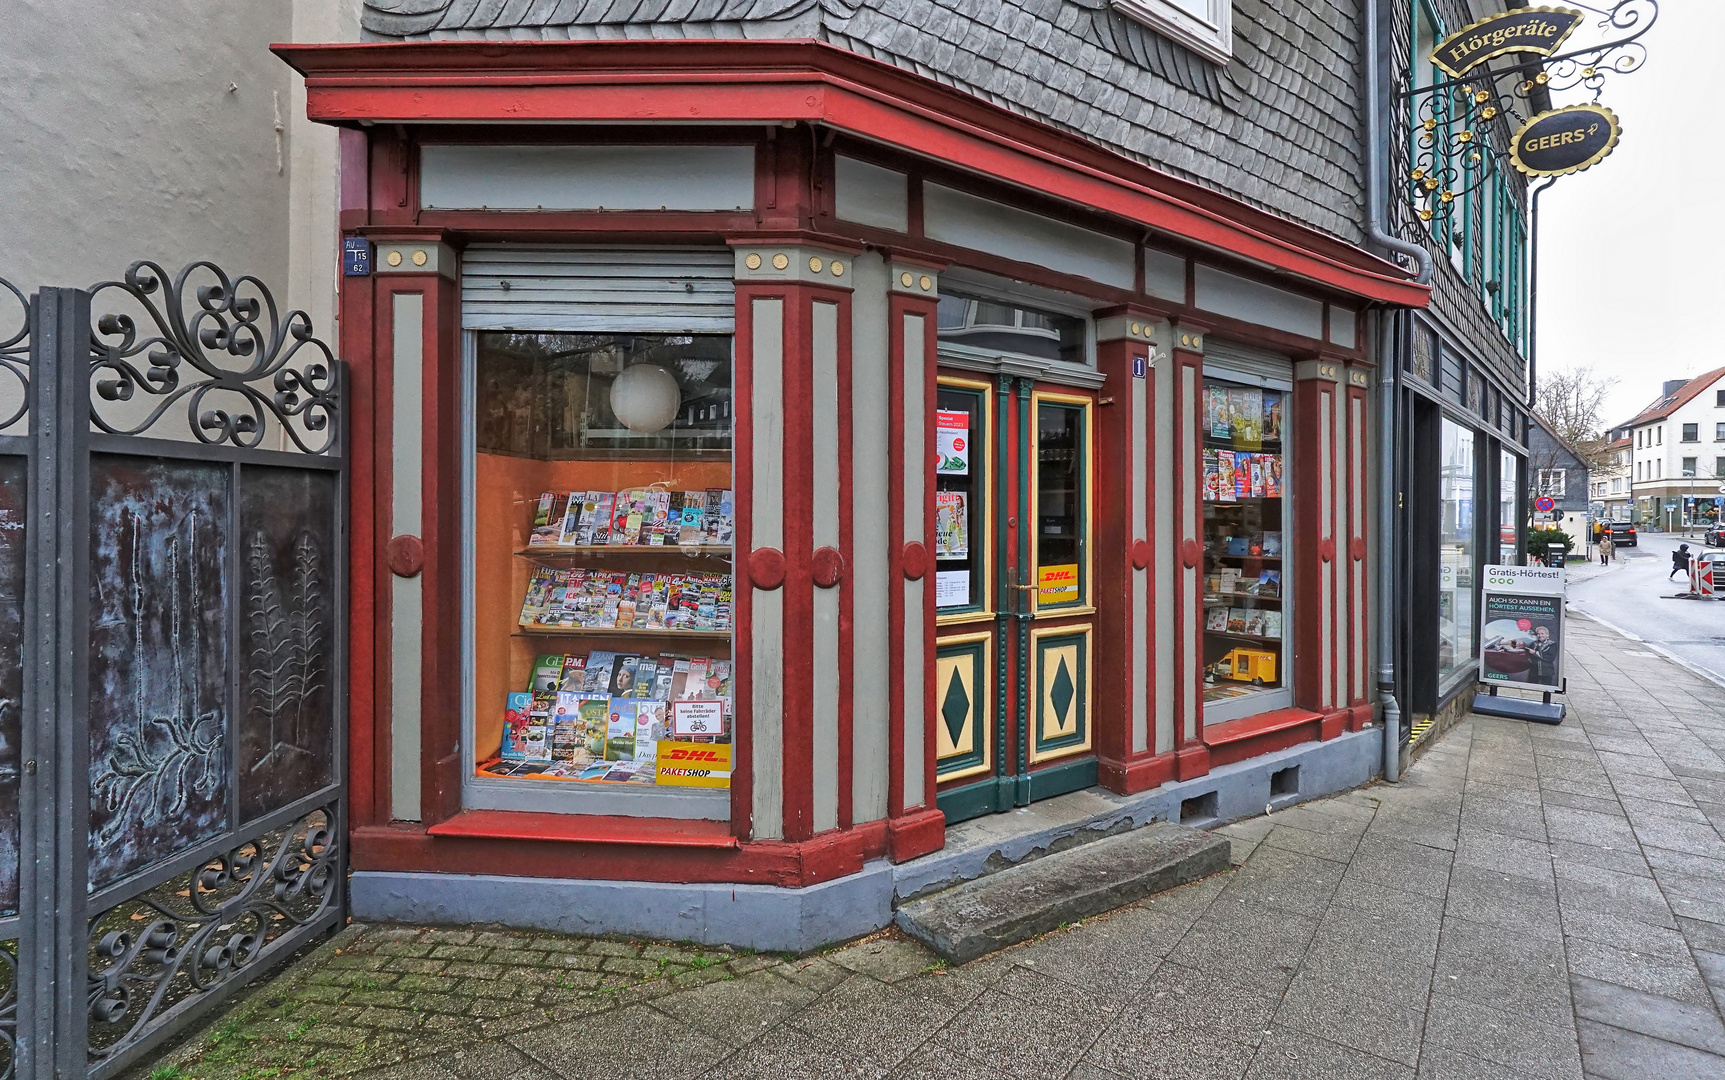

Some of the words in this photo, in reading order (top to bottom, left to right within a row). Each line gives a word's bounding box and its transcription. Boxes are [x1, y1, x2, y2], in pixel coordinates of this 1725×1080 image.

[1448, 19, 1558, 62] Hörgeräte
[1524, 128, 1585, 152] GEERS
[1136, 360, 1142, 376] 1
[1044, 571, 1072, 581] DHL
[1489, 567, 1559, 579] Gratis-Hörtest!
[1040, 586, 1068, 594] PAKETSHOP
[565, 657, 584, 668] P.M.
[1487, 672, 1508, 680] GEERS
[669, 749, 720, 762] DHL
[660, 767, 711, 777] PAKETSHOP
